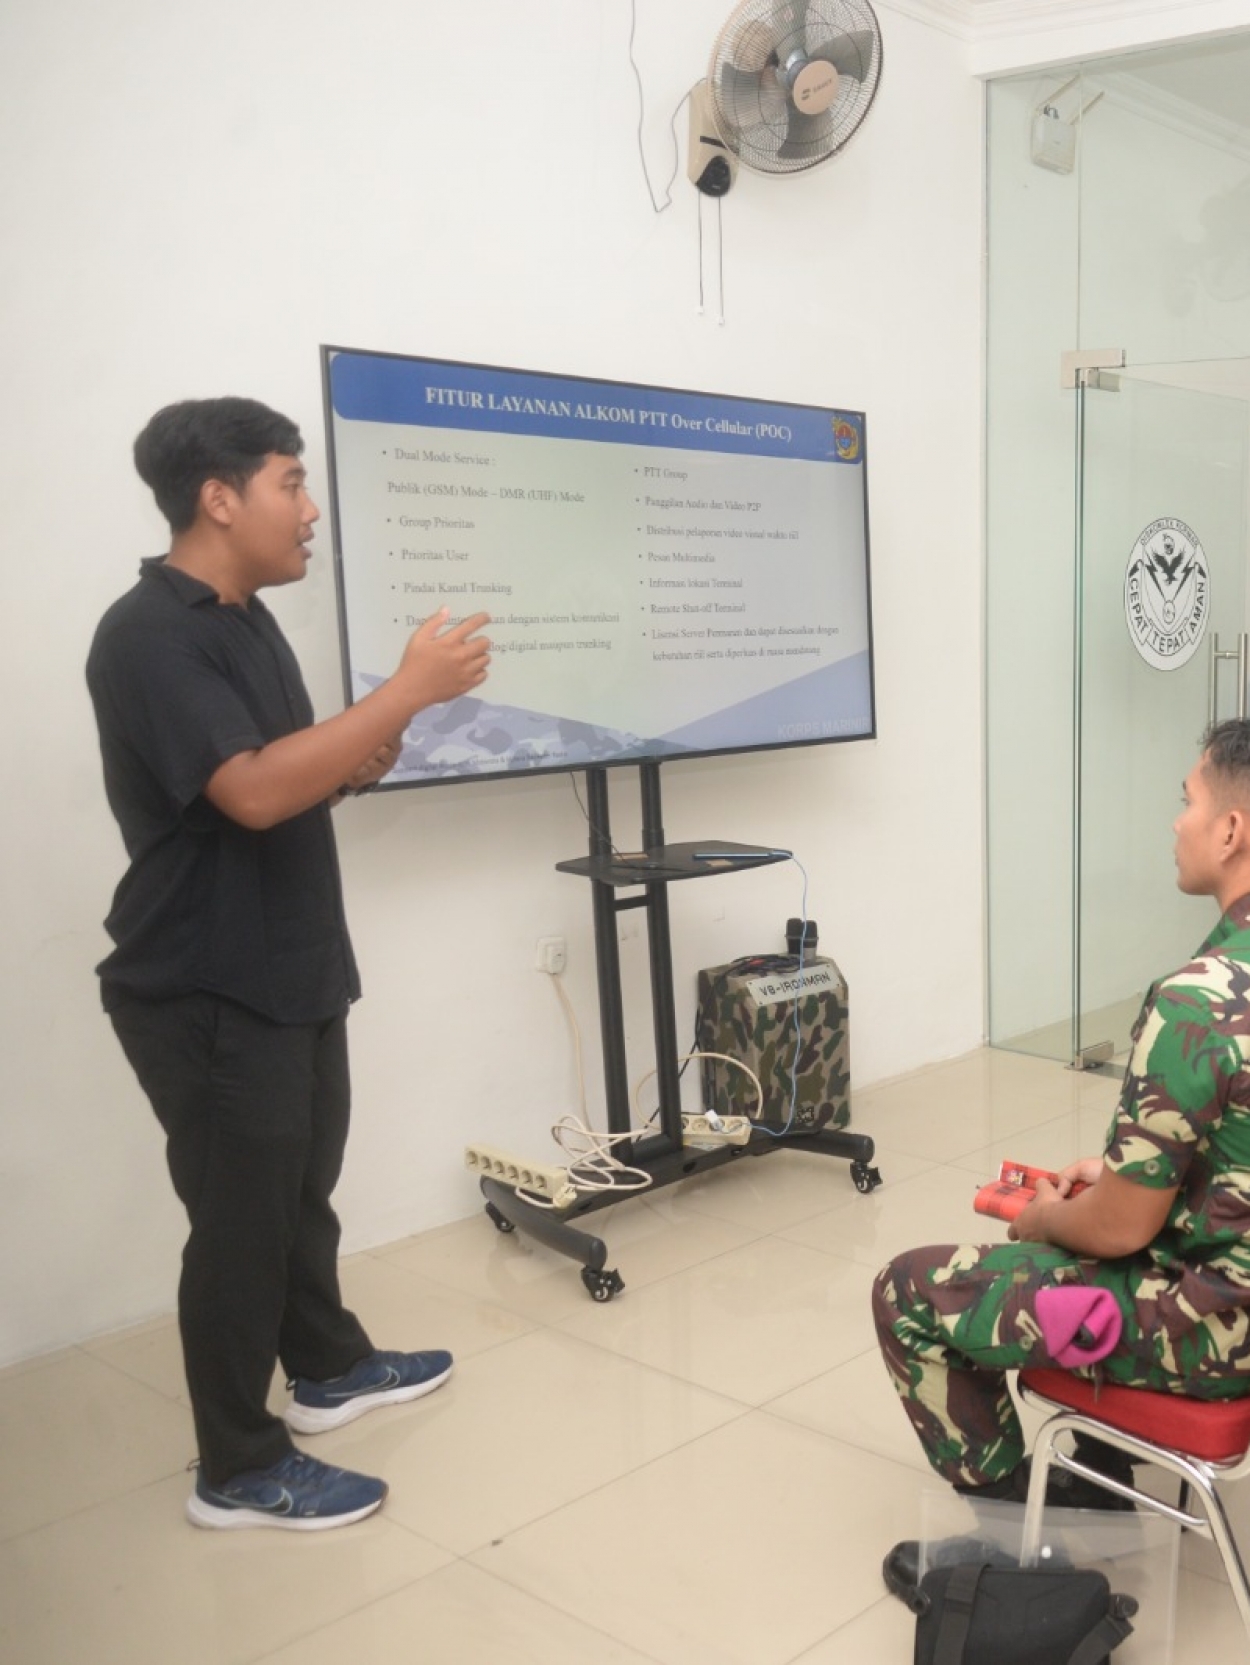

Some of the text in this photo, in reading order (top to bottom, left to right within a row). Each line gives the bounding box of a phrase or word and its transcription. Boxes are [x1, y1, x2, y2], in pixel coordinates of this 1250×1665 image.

[425, 386, 792, 443] FITUR LAYANAN ALKOM PTT Over Cellular (POC)
[394, 448, 420, 462] Dual
[422, 450, 451, 463] Mode
[643, 466, 688, 481] PTT Group
[387, 481, 421, 494] Publik
[422, 483, 459, 498] (GSM)
[460, 484, 489, 498] Mode
[499, 487, 526, 500] DMR
[527, 488, 558, 503] (UHF)
[559, 491, 585, 503] Mode
[398, 515, 476, 531] Group Prioritas
[401, 549, 469, 561] Prioritas User
[403, 581, 436, 594] Pindai
[437, 581, 468, 594] Kanal
[1130, 577, 1149, 634] CEPAT
[1189, 582, 1204, 633] AMAN
[507, 612, 540, 628] dengan
[1152, 630, 1186, 653] TEPAT
